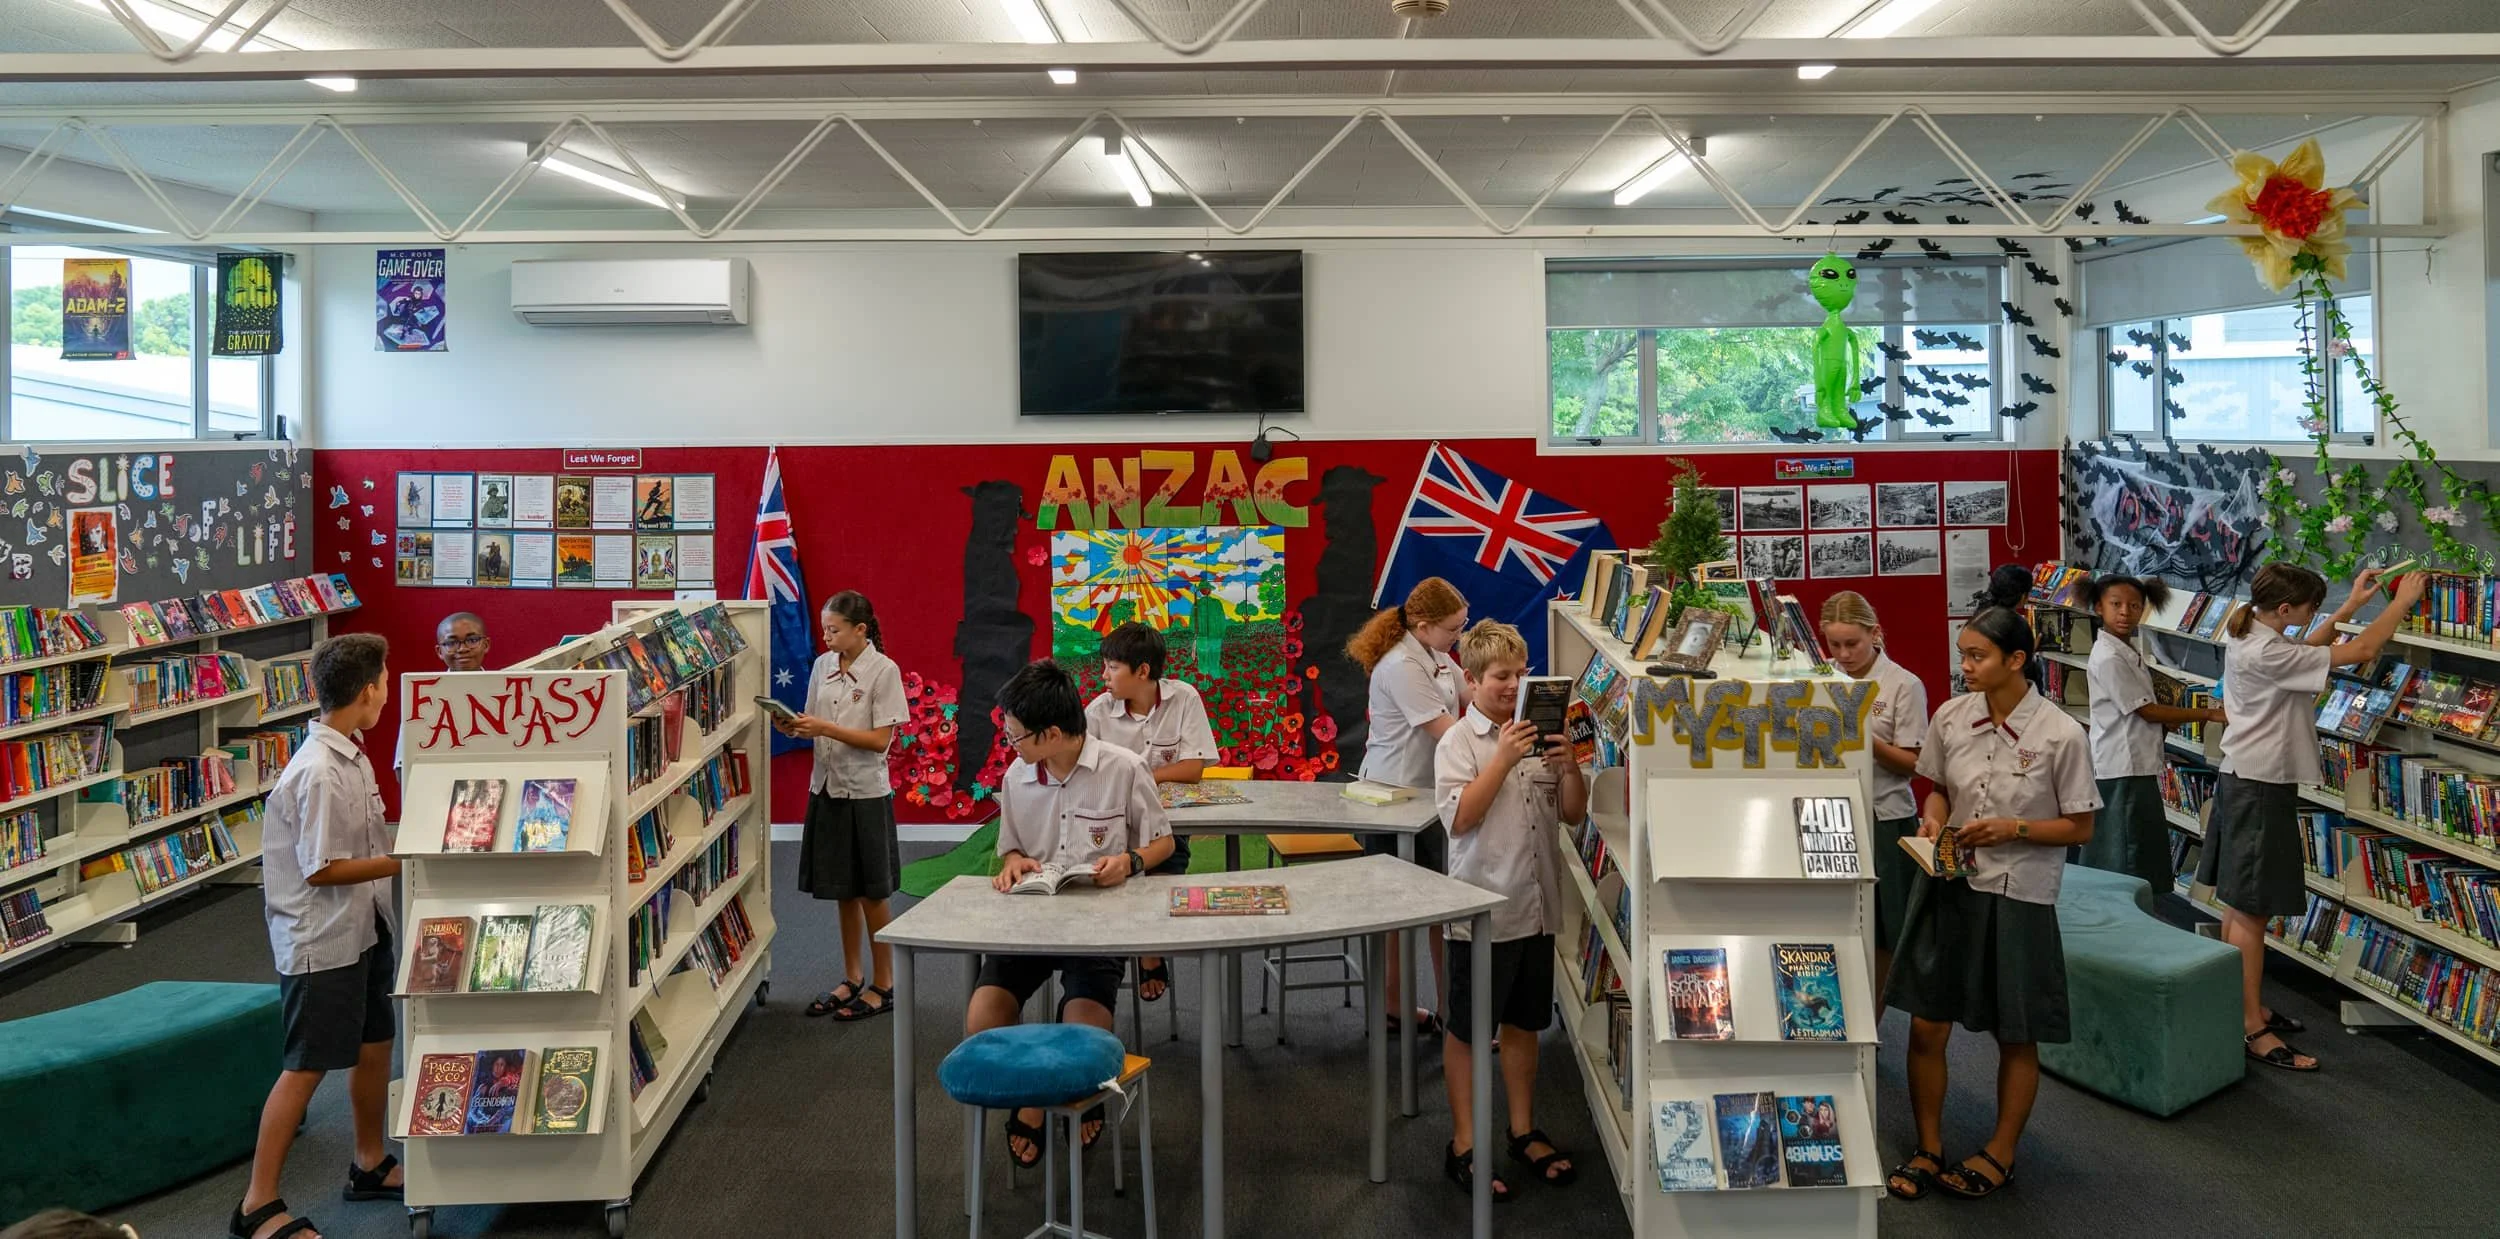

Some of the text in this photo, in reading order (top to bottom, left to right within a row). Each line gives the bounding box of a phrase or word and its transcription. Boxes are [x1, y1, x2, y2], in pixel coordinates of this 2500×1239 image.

[378, 258, 443, 279] GAME OVER
[65, 297, 126, 314] ADAM-2
[227, 334, 271, 350] GRAVITY
[570, 453, 636, 465] Lest We Forget
[1785, 463, 1844, 474] Lest We Forget
[65, 453, 176, 504] SLICE
[1036, 449, 1309, 530] ANZAC
[236, 519, 297, 567] LIFE
[406, 674, 613, 749] FANTASY
[1628, 674, 1881, 769] MYSTERY
[1800, 797, 1850, 833] 400
[1802, 832, 1857, 853] MINUTES
[1805, 854, 1860, 874] DANGER
[1779, 949, 1832, 965] SKANDAR
[429, 1062, 467, 1075] PAGES
[434, 1072, 444, 1082] &
[1661, 1101, 1708, 1163] 2
